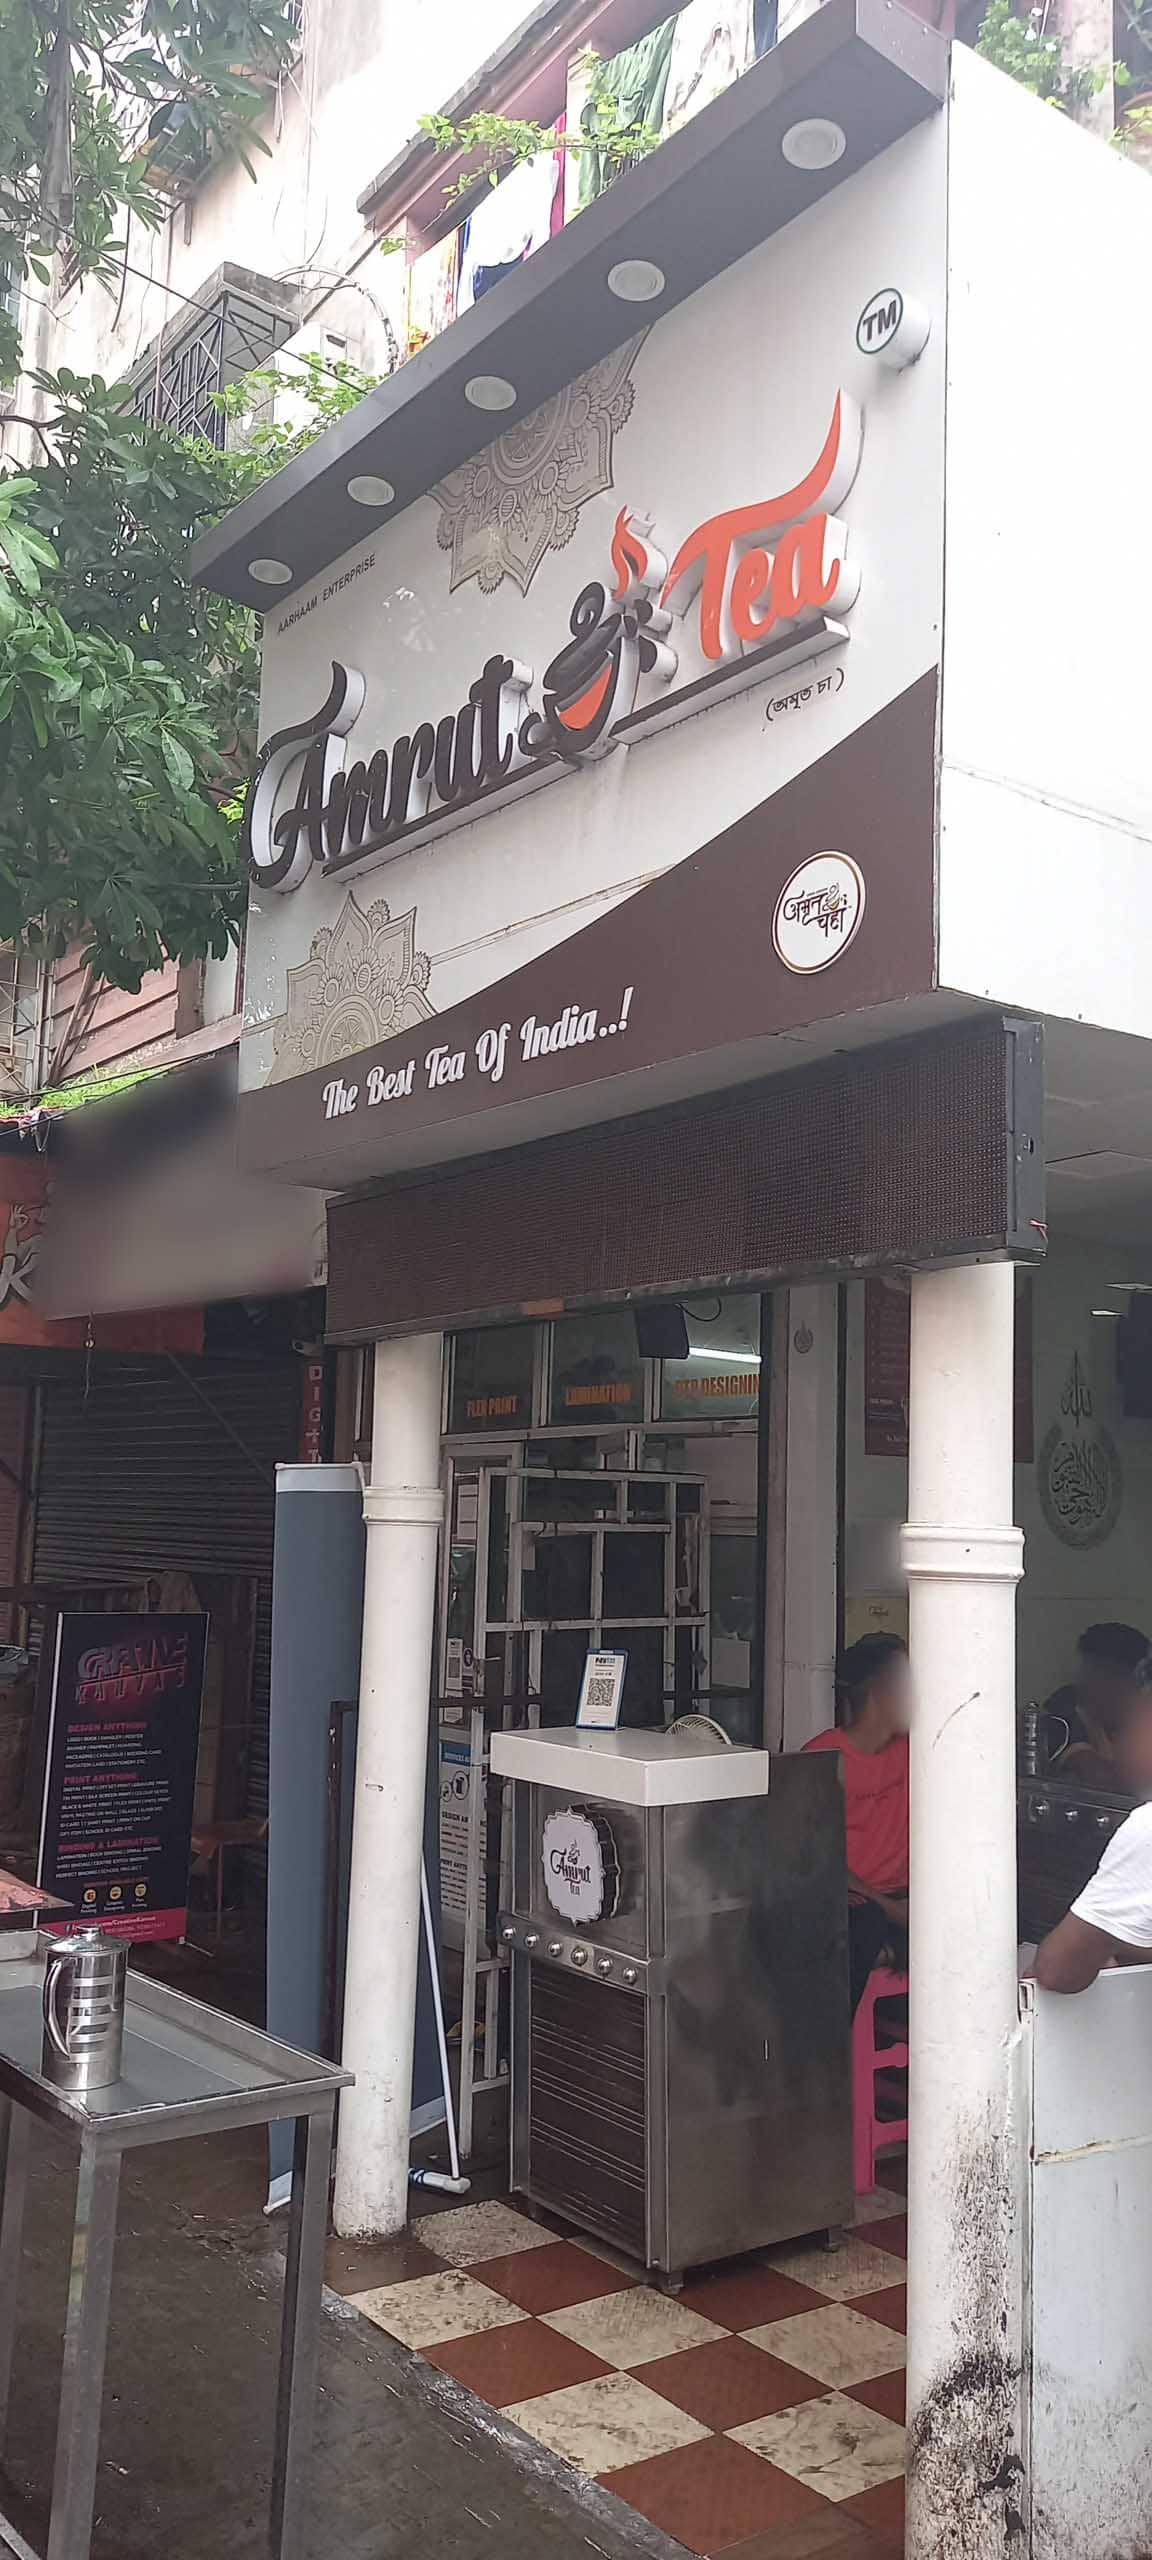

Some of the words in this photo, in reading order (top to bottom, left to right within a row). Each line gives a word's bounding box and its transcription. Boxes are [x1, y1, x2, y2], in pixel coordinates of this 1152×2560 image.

[863, 299, 896, 342] TM
[278, 595, 318, 632] AARHAAM
[322, 553, 376, 601] ENTERPRISE
[250, 659, 513, 889] Amrut
[659, 387, 841, 660] Tea
[322, 1078, 359, 1119] The
[366, 1059, 416, 1106] Best
[425, 1044, 466, 1089] Tea
[475, 1022, 512, 1082] Of
[550, 1848, 592, 1884] Amrut
